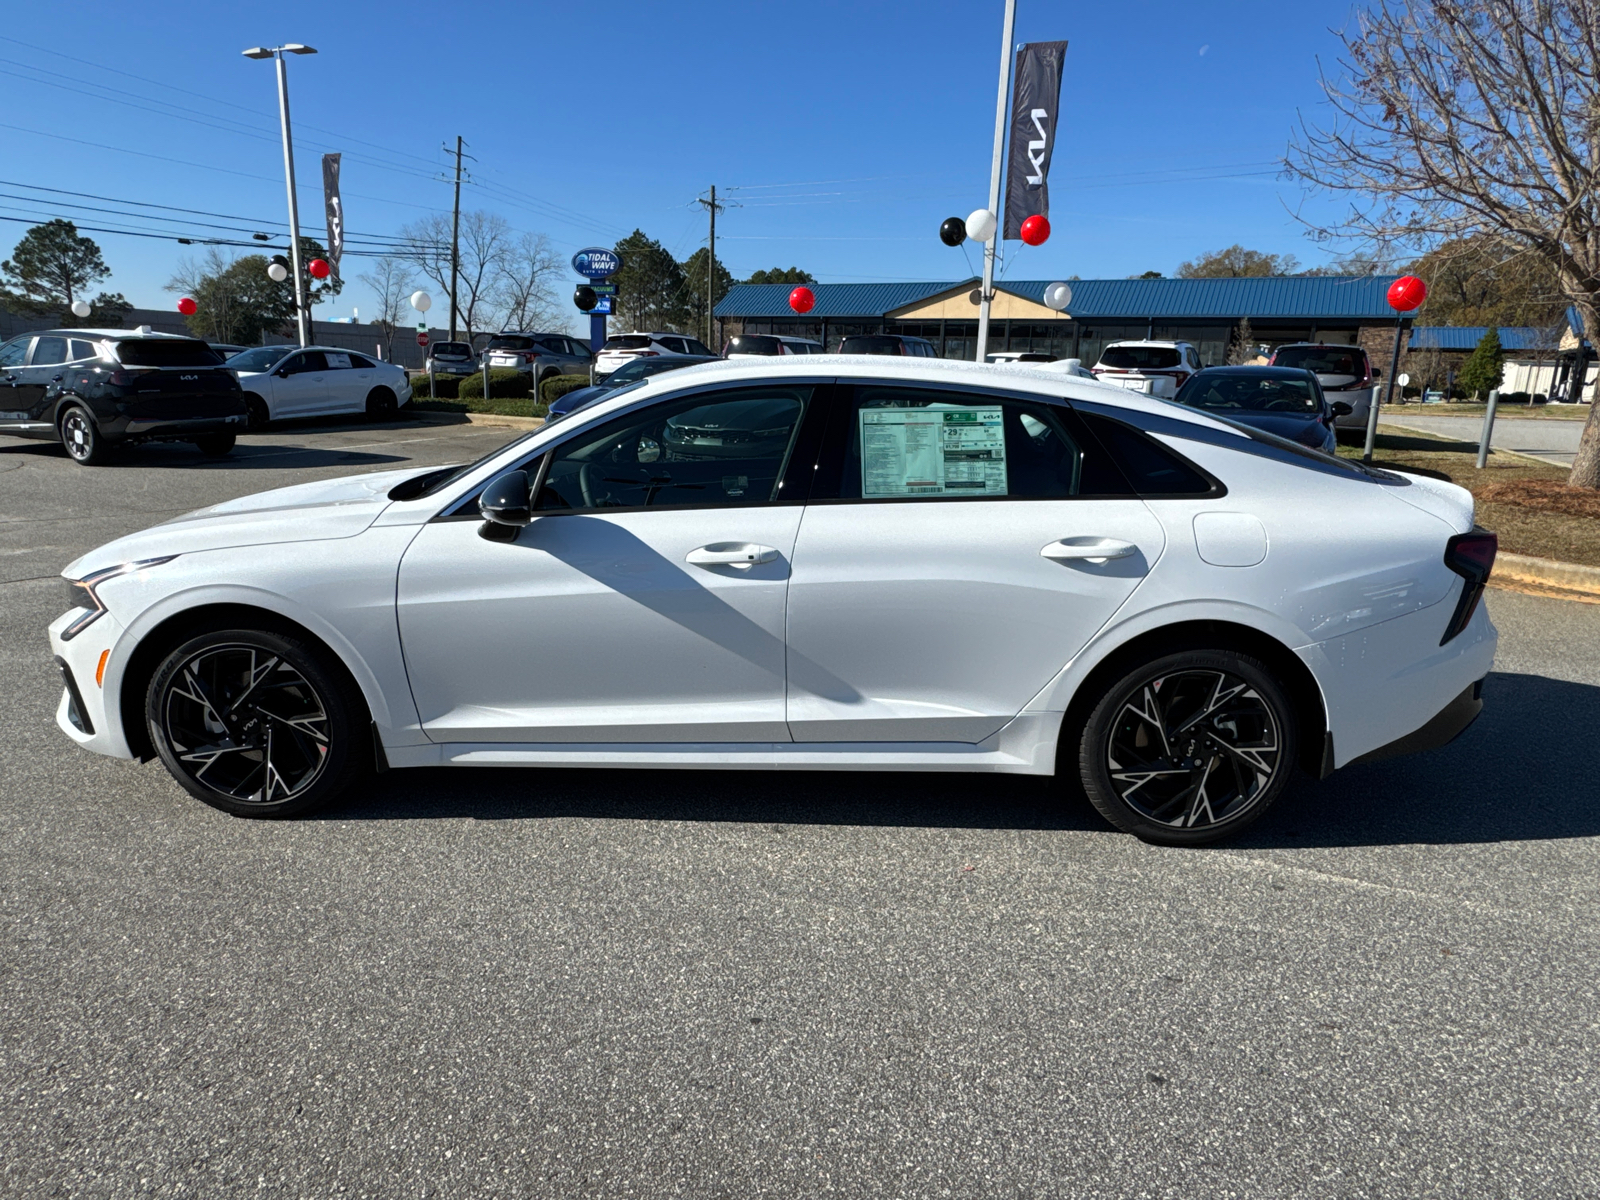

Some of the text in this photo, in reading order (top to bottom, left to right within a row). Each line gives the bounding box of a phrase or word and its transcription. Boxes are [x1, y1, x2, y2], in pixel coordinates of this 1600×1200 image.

[1026, 108, 1048, 185] KIA
[588, 253, 611, 261] TIDAL
[591, 262, 616, 270] WAVE
[947, 428, 958, 436] 29
